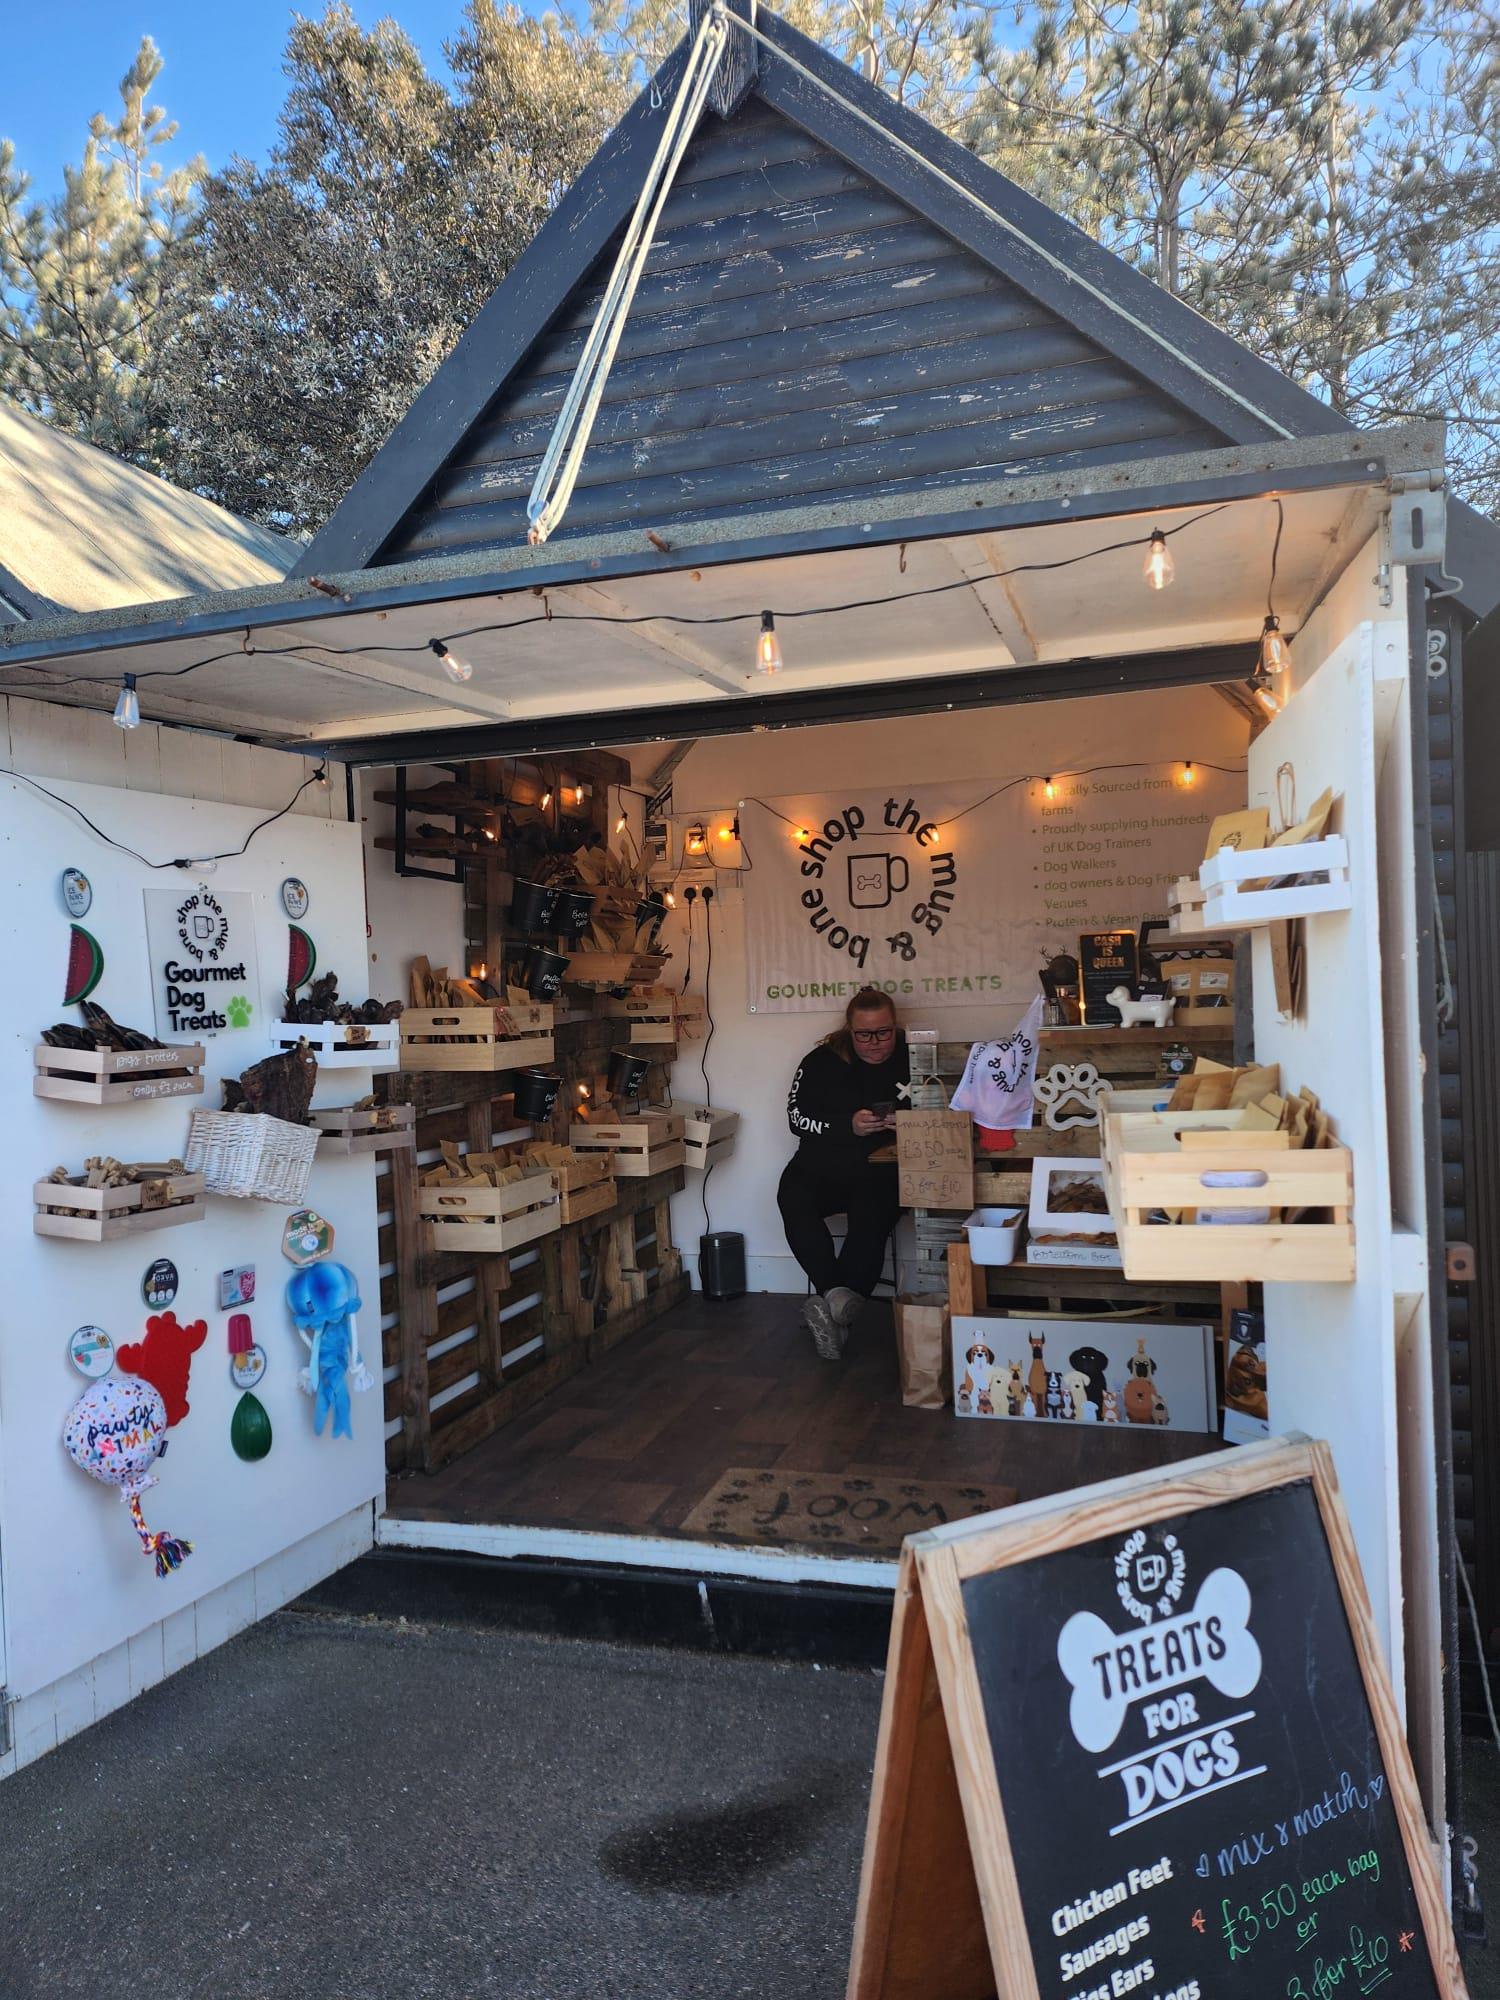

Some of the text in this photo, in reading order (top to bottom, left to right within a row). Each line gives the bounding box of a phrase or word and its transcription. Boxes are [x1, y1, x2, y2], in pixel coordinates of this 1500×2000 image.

[1092, 781, 1141, 794] Sourced
[1143, 779, 1173, 790] from
[1041, 806, 1074, 817] farms
[1042, 813, 1210, 837] Proudly supplying hundreds
[1043, 837, 1152, 854] of UK Dog Trainers
[1043, 858, 1117, 874] Dog Walkers
[799, 798, 957, 969] the mug & bone shop
[1044, 879, 1067, 892] dog
[1070, 877, 1113, 889] owners
[1116, 875, 1126, 886] &
[1128, 874, 1153, 887] Dog
[1044, 898, 1088, 910] Venues
[176, 893, 229, 964] the mug & bone shop
[1045, 916, 1089, 928] Protein
[1091, 915, 1100, 926] &
[1102, 914, 1139, 928] Vegan
[1094, 935, 1122, 946] CASH
[1102, 946, 1114, 957] IS
[164, 960, 247, 984] Gourmet
[1092, 956, 1125, 969] QUEEN
[166, 985, 206, 1013] Dog
[766, 975, 1003, 999] GOURMET DOG TREATS
[167, 1010, 228, 1032] Treats
[87, 1403, 156, 1449] pawty
[1092, 1615, 1227, 1700] TREATS
[1142, 1691, 1200, 1739] FOR
[1120, 1729, 1240, 1817] DOGS
[1217, 1832, 1274, 1877] mix
[1293, 1771, 1368, 1837] match
[1301, 1870, 1346, 1903] each
[1347, 1849, 1381, 1882] bag
[1051, 1856, 1174, 1937] Chicken Feet
[1297, 1911, 1319, 1938] or
[1059, 1915, 1151, 1982] Sausages
[1312, 1957, 1348, 2000] for
[1350, 1924, 1390, 1978] £10
[1110, 1958, 1155, 1998] Ears
